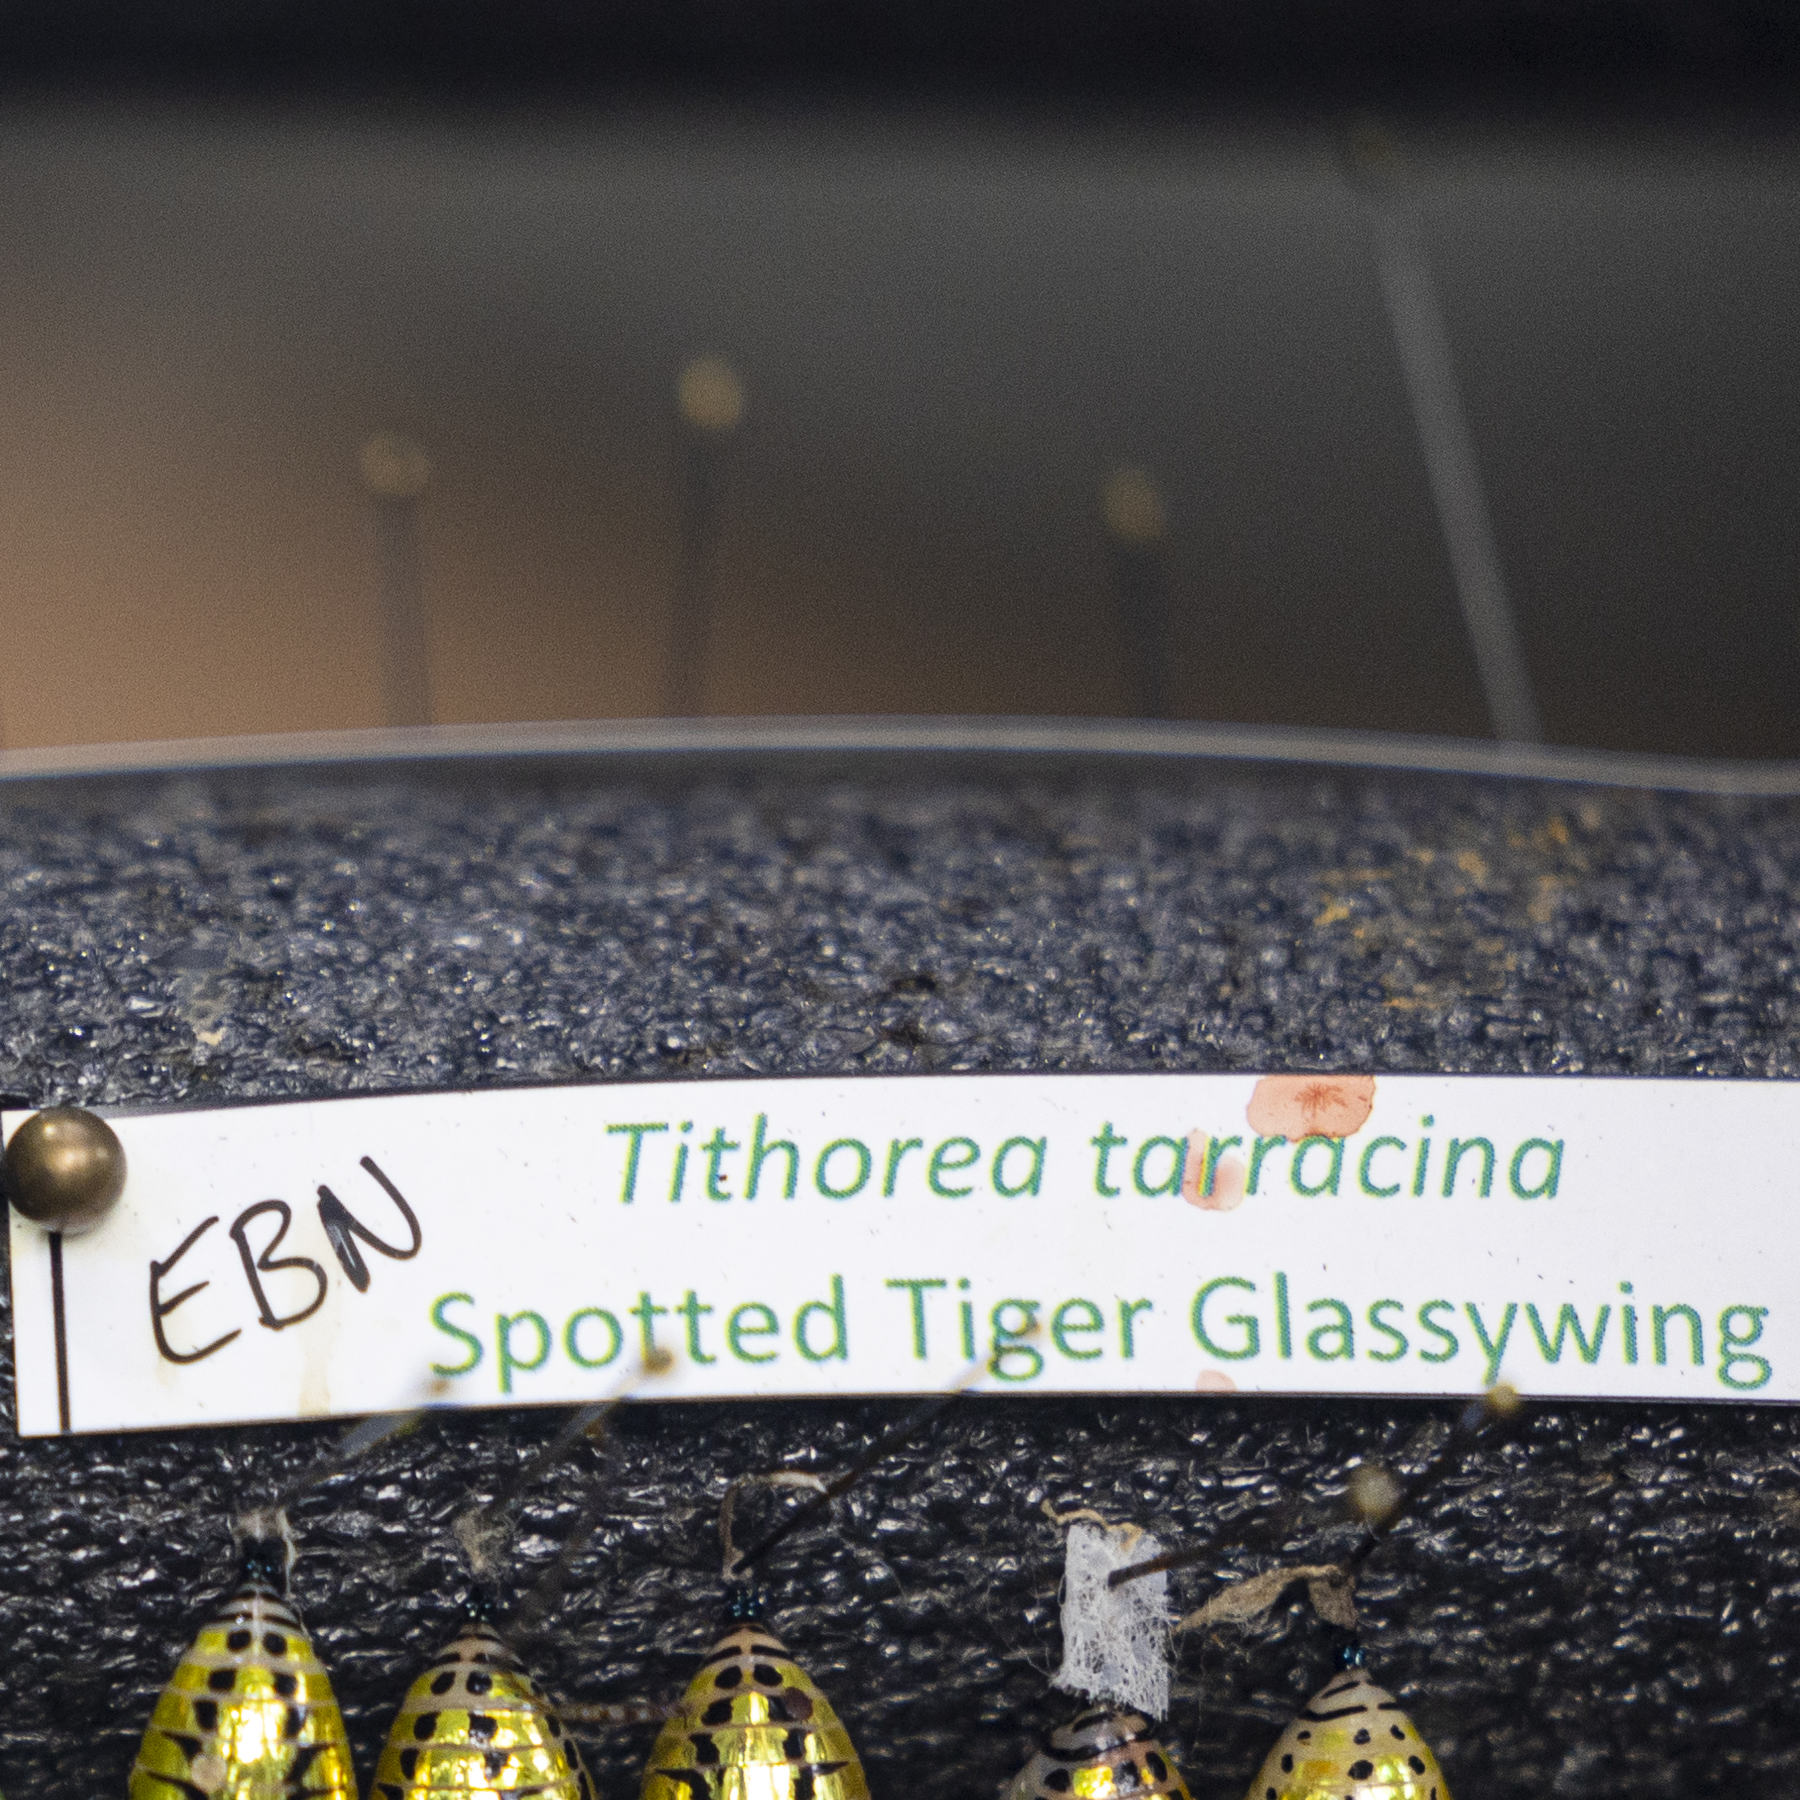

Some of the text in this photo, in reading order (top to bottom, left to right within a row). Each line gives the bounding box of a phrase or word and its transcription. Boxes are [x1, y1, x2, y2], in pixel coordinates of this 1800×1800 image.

[605, 1112, 1566, 1203] Tithorea tarracina
[148, 1154, 423, 1366] EBN
[430, 1270, 1773, 1394] Spotted Tiger Glassywing
